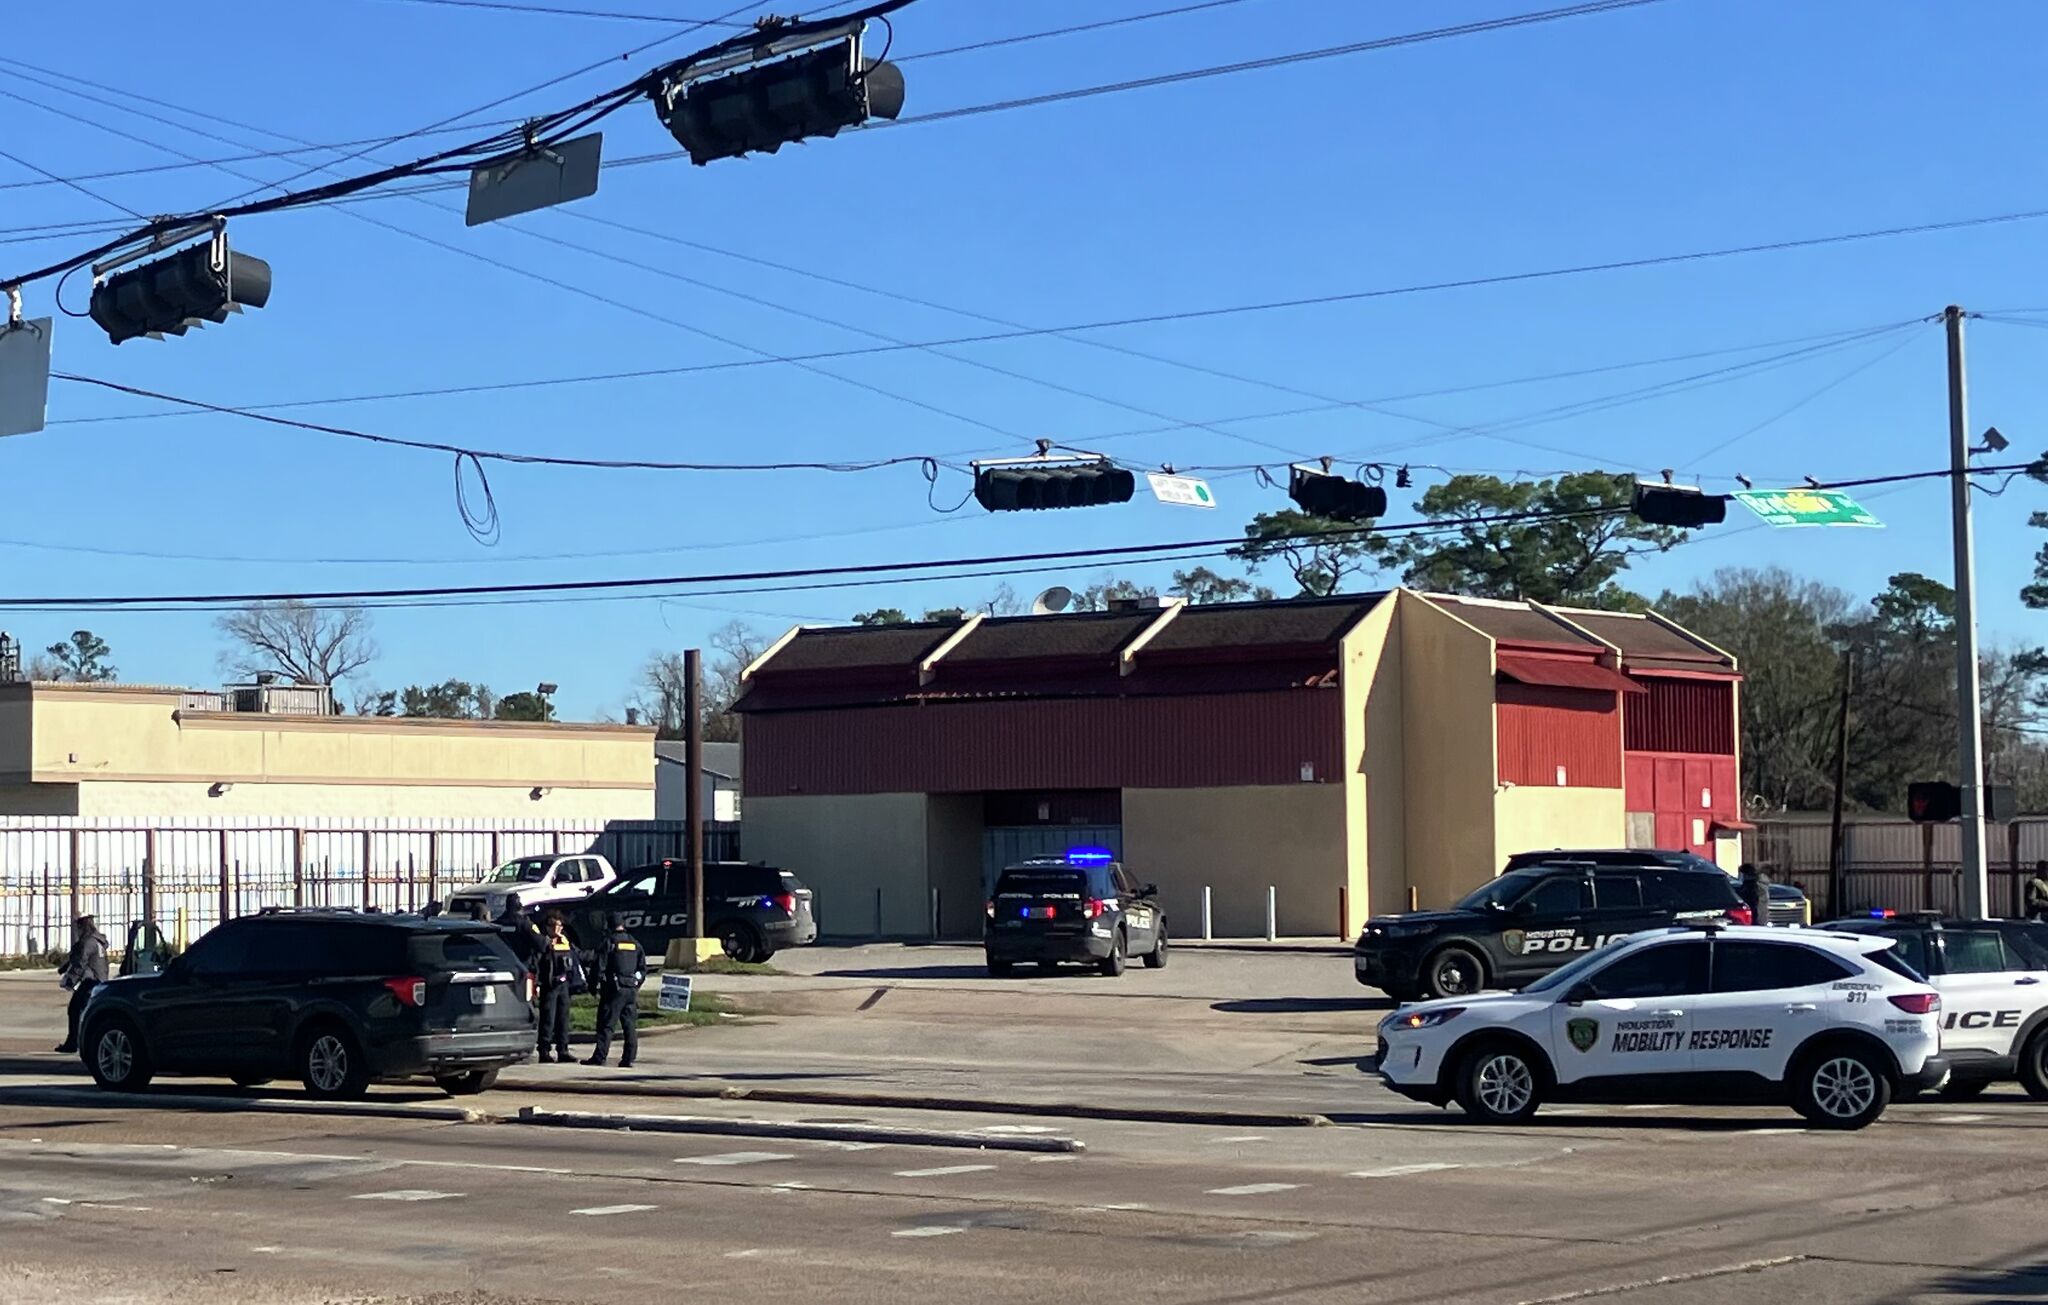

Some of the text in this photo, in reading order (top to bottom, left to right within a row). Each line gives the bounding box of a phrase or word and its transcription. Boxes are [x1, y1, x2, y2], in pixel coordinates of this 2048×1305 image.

[625, 913, 688, 928] OLIC
[1125, 914, 1150, 929] POLICE
[1525, 928, 1576, 939] HOUSTON
[1846, 991, 1868, 1003] 911
[1616, 1019, 1675, 1031] HOUSTON
[1611, 1028, 1774, 1053] MOBILITY RESPONSE
